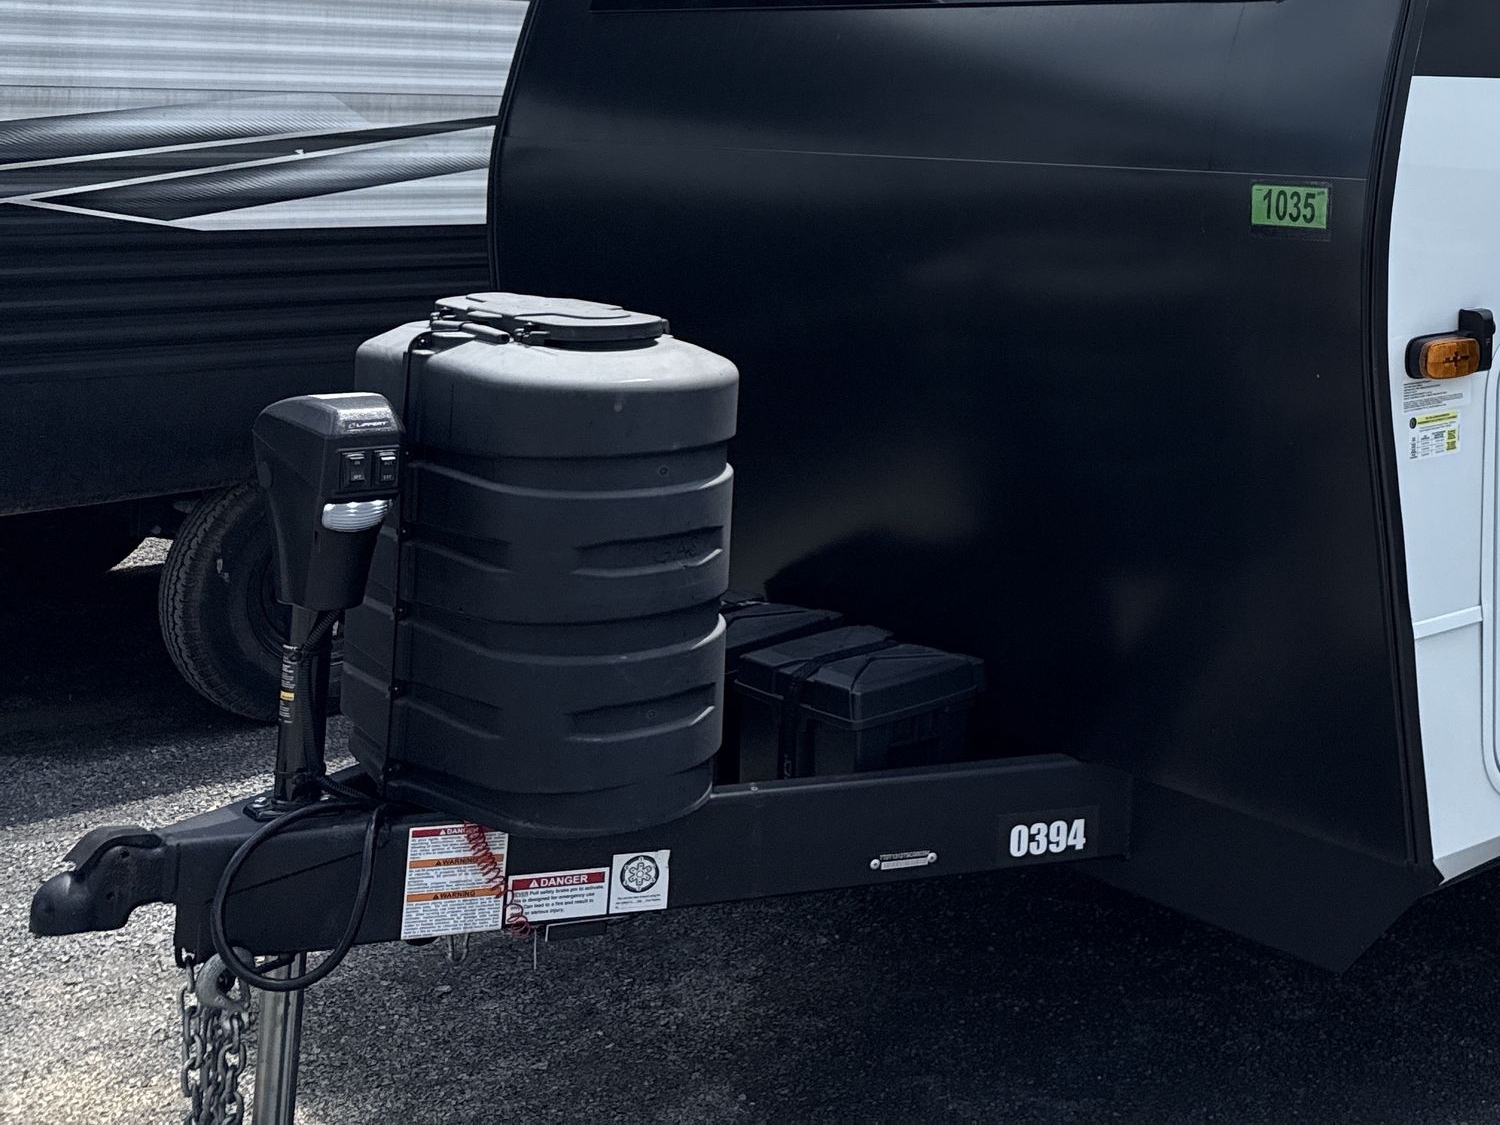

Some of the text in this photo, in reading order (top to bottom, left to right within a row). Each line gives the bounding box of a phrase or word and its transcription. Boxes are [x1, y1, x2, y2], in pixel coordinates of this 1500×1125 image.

[1263, 188, 1316, 224] 1035
[446, 826, 479, 835] DAN
[1009, 818, 1087, 858] 0394
[540, 874, 588, 887] DANGER
[440, 889, 476, 899] WARNING
